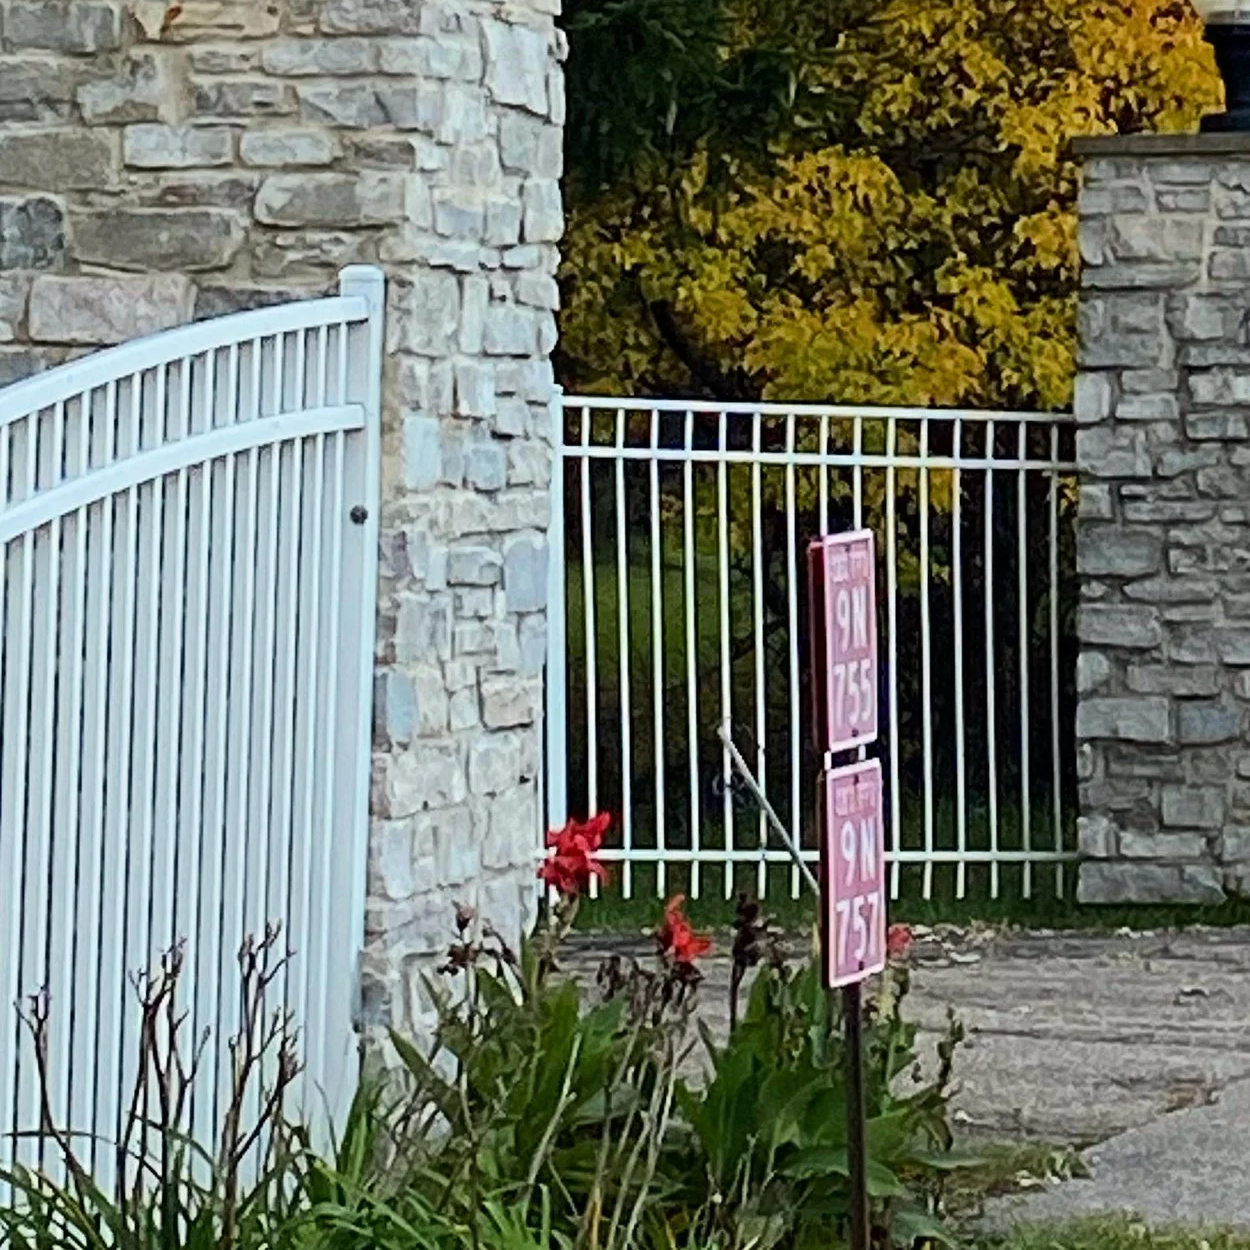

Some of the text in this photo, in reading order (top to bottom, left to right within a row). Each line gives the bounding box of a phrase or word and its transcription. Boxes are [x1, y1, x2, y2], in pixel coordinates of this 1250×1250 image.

[836, 585, 867, 652] 9N
[833, 658, 871, 727] 755
[840, 818, 876, 887] 9N
[836, 892, 878, 966] 757
